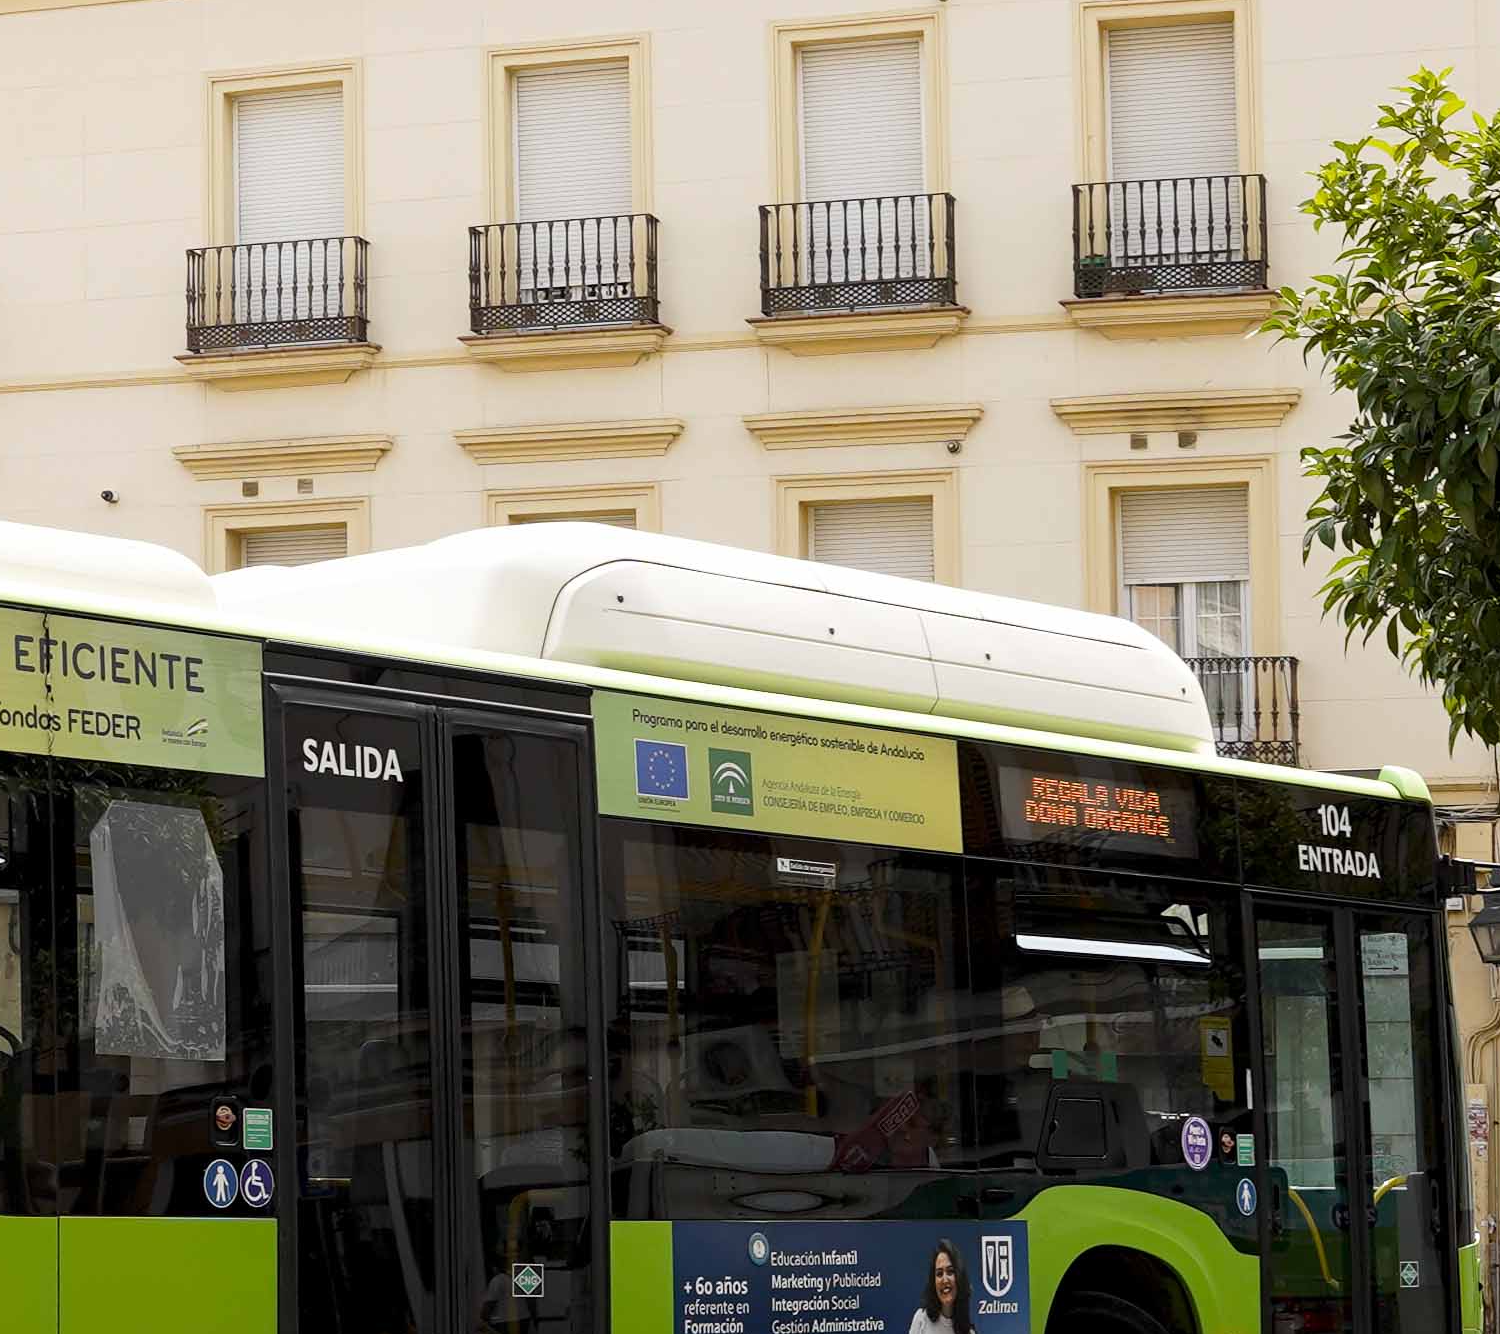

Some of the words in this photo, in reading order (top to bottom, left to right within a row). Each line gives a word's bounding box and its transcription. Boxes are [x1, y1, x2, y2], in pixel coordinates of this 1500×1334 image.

[14, 631, 205, 694] EFICIENTE
[67, 709, 141, 741] FEDER
[632, 709, 683, 732] Programa
[685, 719, 708, 733] para
[710, 720, 719, 733] el
[721, 723, 767, 741] desarrollo
[770, 728, 818, 747] energético
[820, 735, 865, 753] sostenible
[867, 740, 878, 754] de
[881, 740, 925, 761] Andalucía
[303, 738, 403, 783] SALIDA
[1032, 777, 1109, 807] REGALA
[1115, 787, 1160, 813] VIDA
[808, 801, 819, 813] DE
[851, 806, 882, 820] EMPRESA
[1025, 799, 1077, 826] DONA
[1317, 804, 1352, 838] 104
[1298, 844, 1381, 879] ENTRADA
[771, 1251, 820, 1266] Educación
[822, 1250, 858, 1266] Infantil
[695, 1276, 713, 1295] 60
[716, 1276, 748, 1295] años
[771, 1274, 824, 1292] Marketing
[825, 1278, 831, 1291] y
[833, 1272, 881, 1288] Publicidad
[684, 1299, 734, 1315] referente
[736, 1302, 749, 1315] en
[771, 1296, 830, 1316] Integración
[831, 1294, 860, 1310] Social
[978, 1299, 1018, 1314] Zalima
[684, 1318, 743, 1334] Formación
[771, 1319, 810, 1334] Gestión
[812, 1316, 884, 1333] Administrativa
